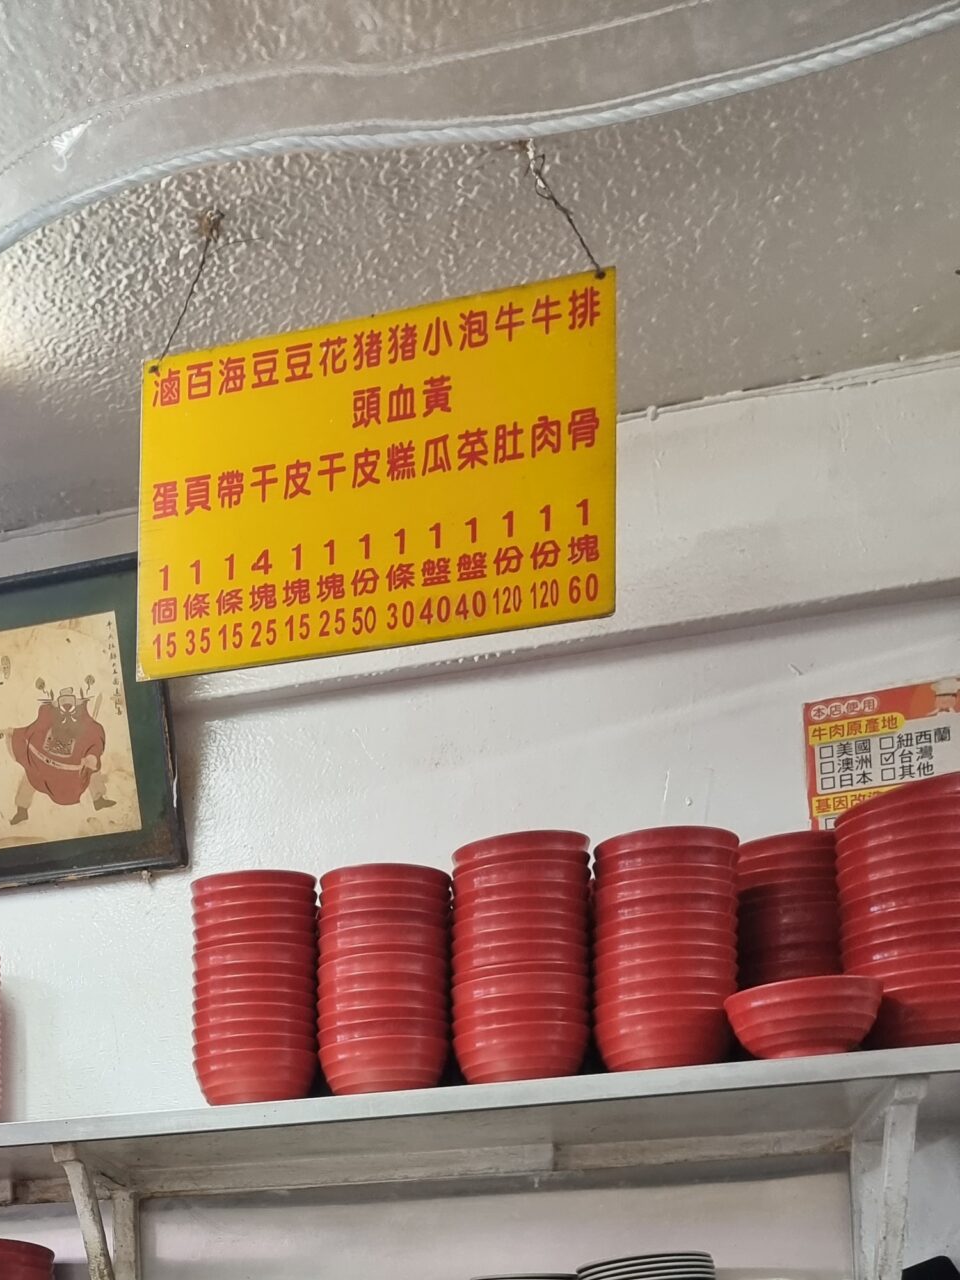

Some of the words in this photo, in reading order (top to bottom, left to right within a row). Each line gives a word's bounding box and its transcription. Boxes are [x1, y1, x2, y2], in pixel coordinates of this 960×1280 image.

[452, 587, 489, 620] 40
[492, 585, 524, 617] 120
[530, 577, 561, 609] 120
[567, 572, 601, 605] 60
[319, 602, 348, 638] 25
[351, 604, 378, 637] 50
[386, 599, 417, 632] 30
[417, 589, 454, 624] 40
[185, 626, 212, 656] 35
[218, 621, 244, 650] 15
[250, 618, 278, 649] 25
[285, 612, 312, 641] 15
[152, 631, 178, 660] 15
[811, 698, 877, 719] 本店使用
[811, 714, 898, 741] 牛肉原產地
[836, 739, 871, 757] 美國
[897, 727, 951, 749] 紐西蘭
[838, 754, 872, 774] 澳洲
[899, 745, 933, 763] 台灣
[840, 771, 873, 788] 日本
[899, 762, 934, 780] 其他
